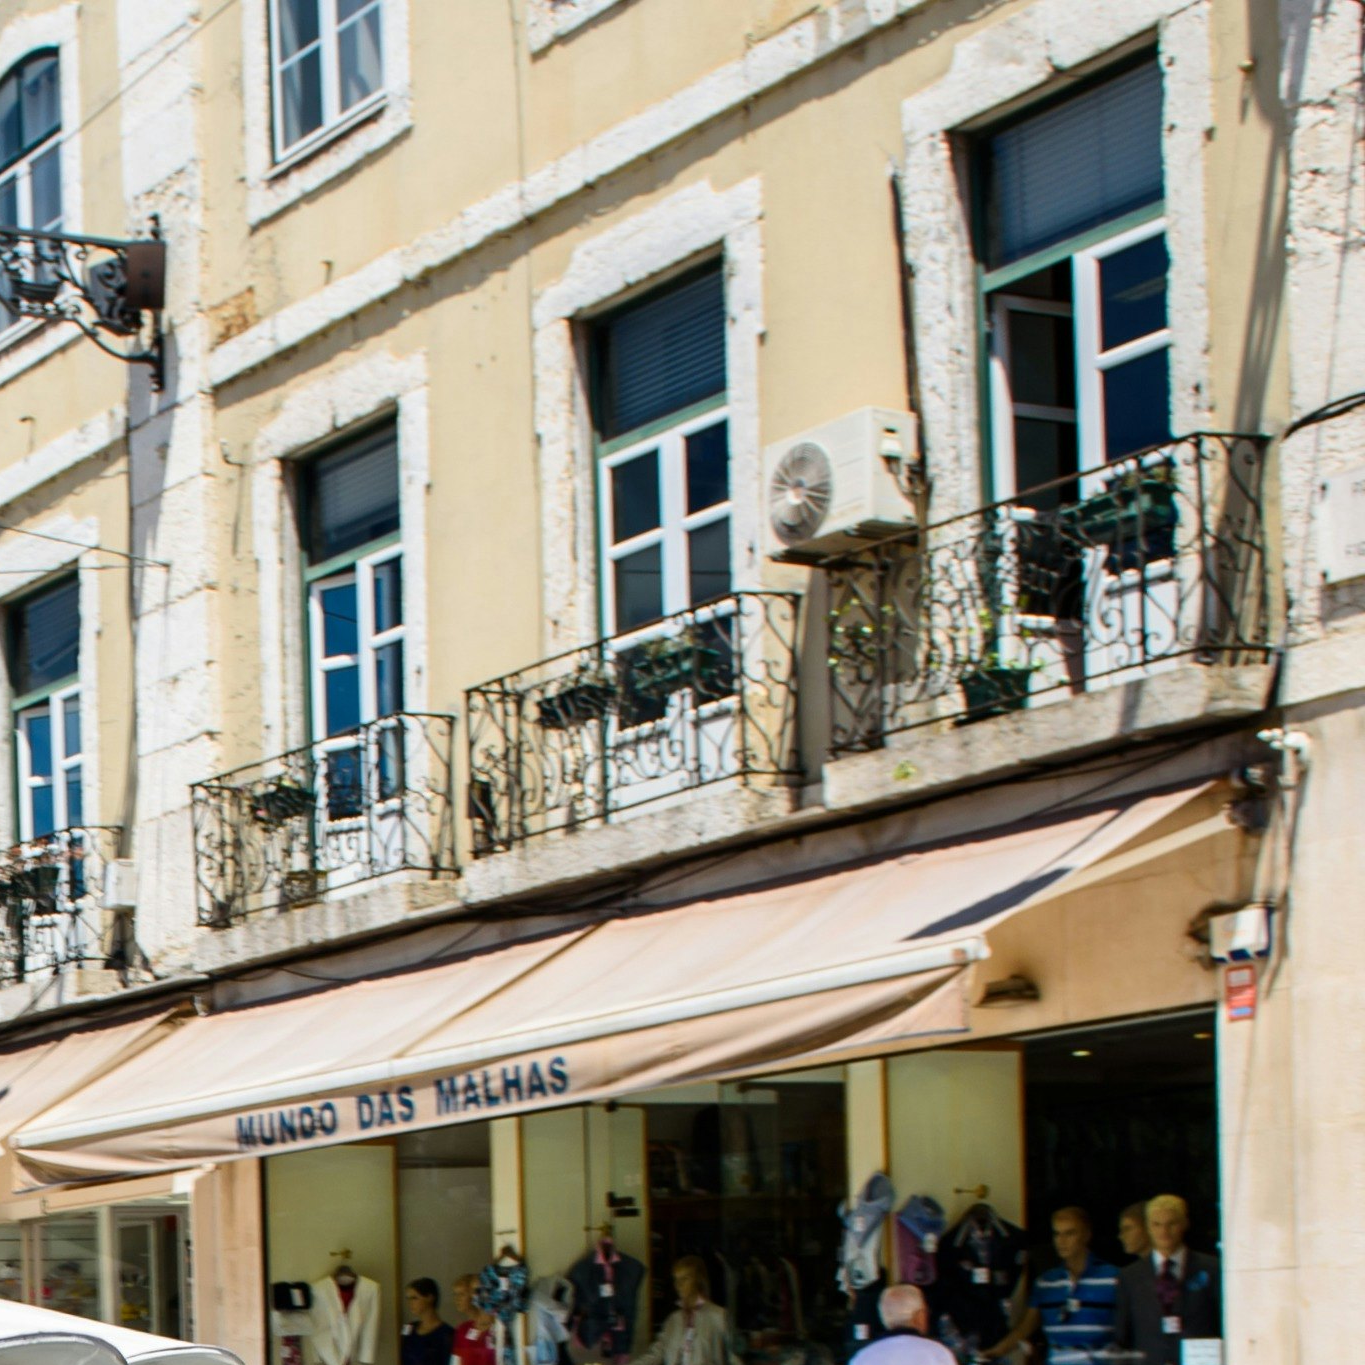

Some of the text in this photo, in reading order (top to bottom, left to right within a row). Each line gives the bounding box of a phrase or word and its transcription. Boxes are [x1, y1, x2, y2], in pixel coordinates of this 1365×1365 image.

[236, 1056, 569, 1147] MUNDO DAS MALHAS
